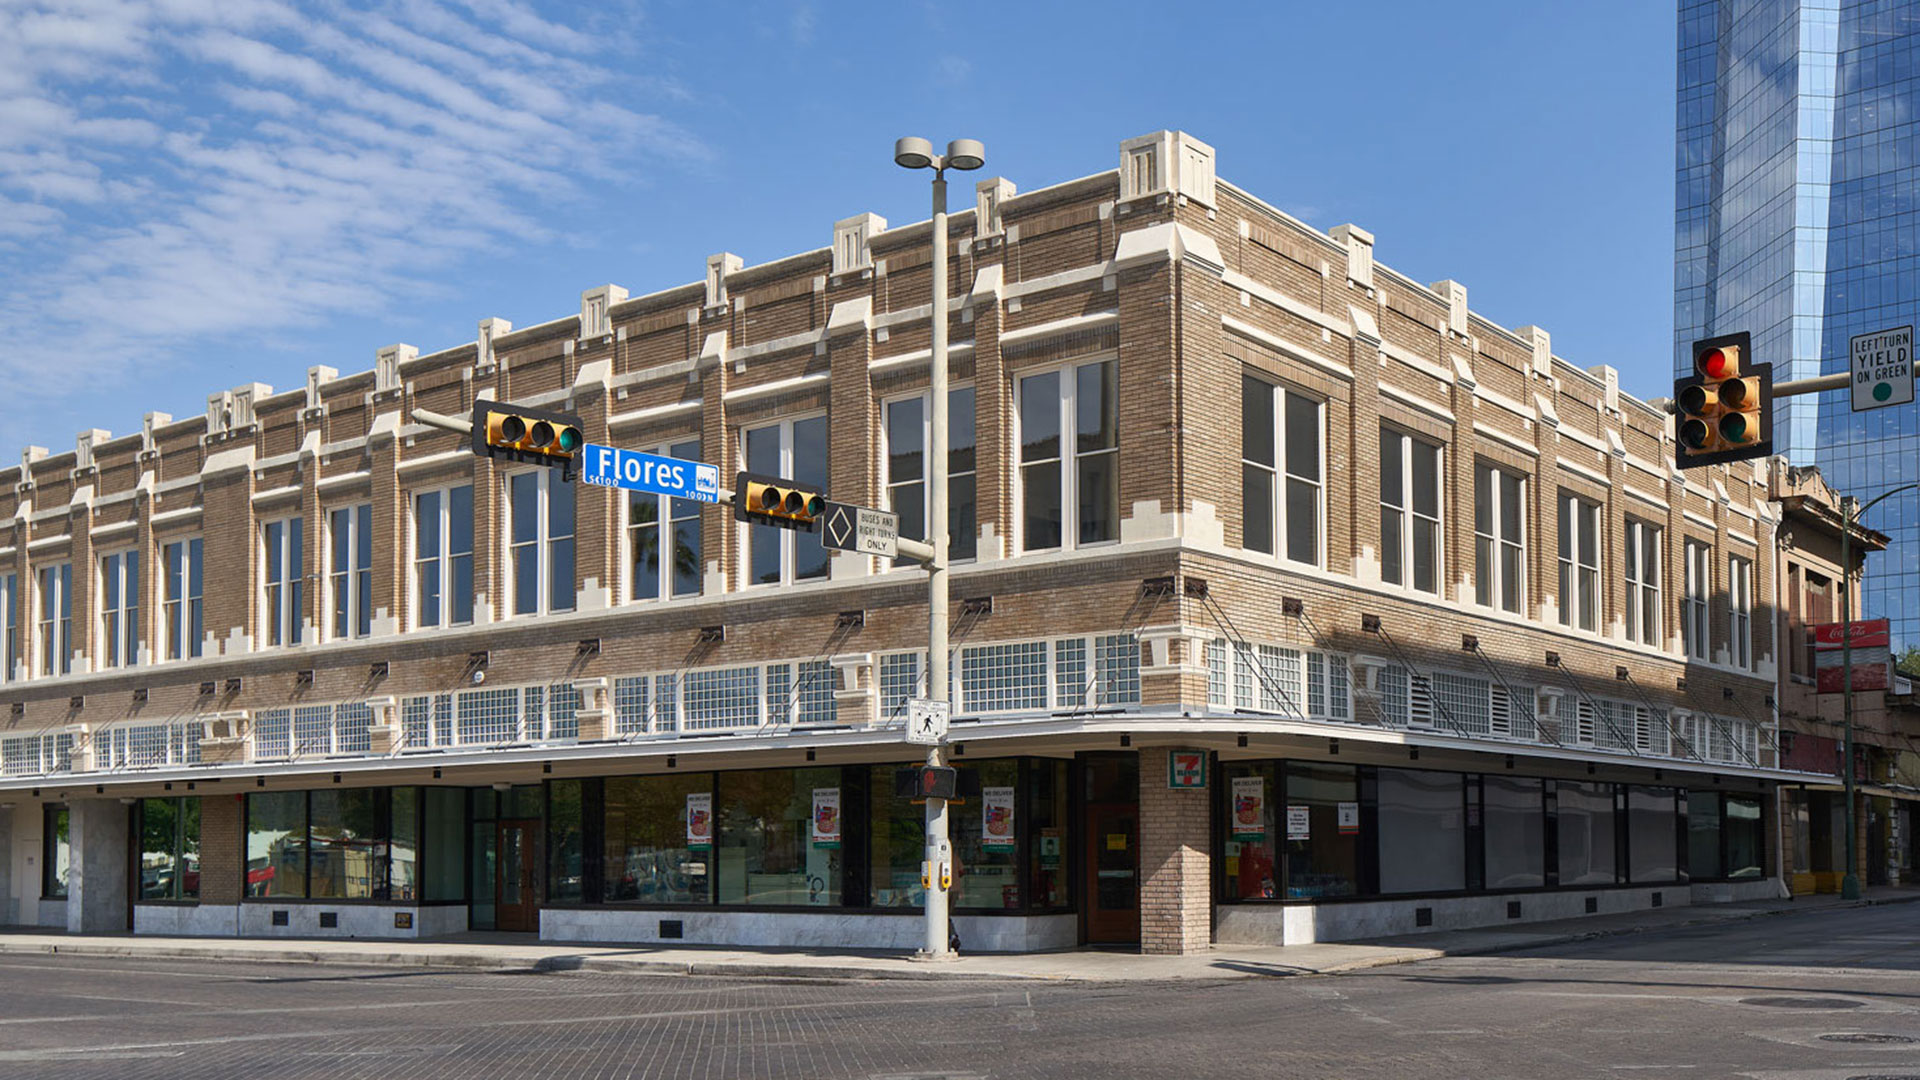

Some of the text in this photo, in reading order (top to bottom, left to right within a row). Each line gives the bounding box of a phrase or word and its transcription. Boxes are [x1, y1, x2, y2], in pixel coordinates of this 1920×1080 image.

[1855, 332, 1909, 353] LEFT TURN
[1858, 347, 1907, 369] YIELD
[1857, 364, 1907, 384] ON GREEN
[599, 449, 685, 489] Flores
[861, 513, 894, 527] BUSES AND
[859, 525, 895, 540] RIGHT TURNS
[867, 539, 887, 551] ONLY
[1175, 755, 1200, 785] 7
